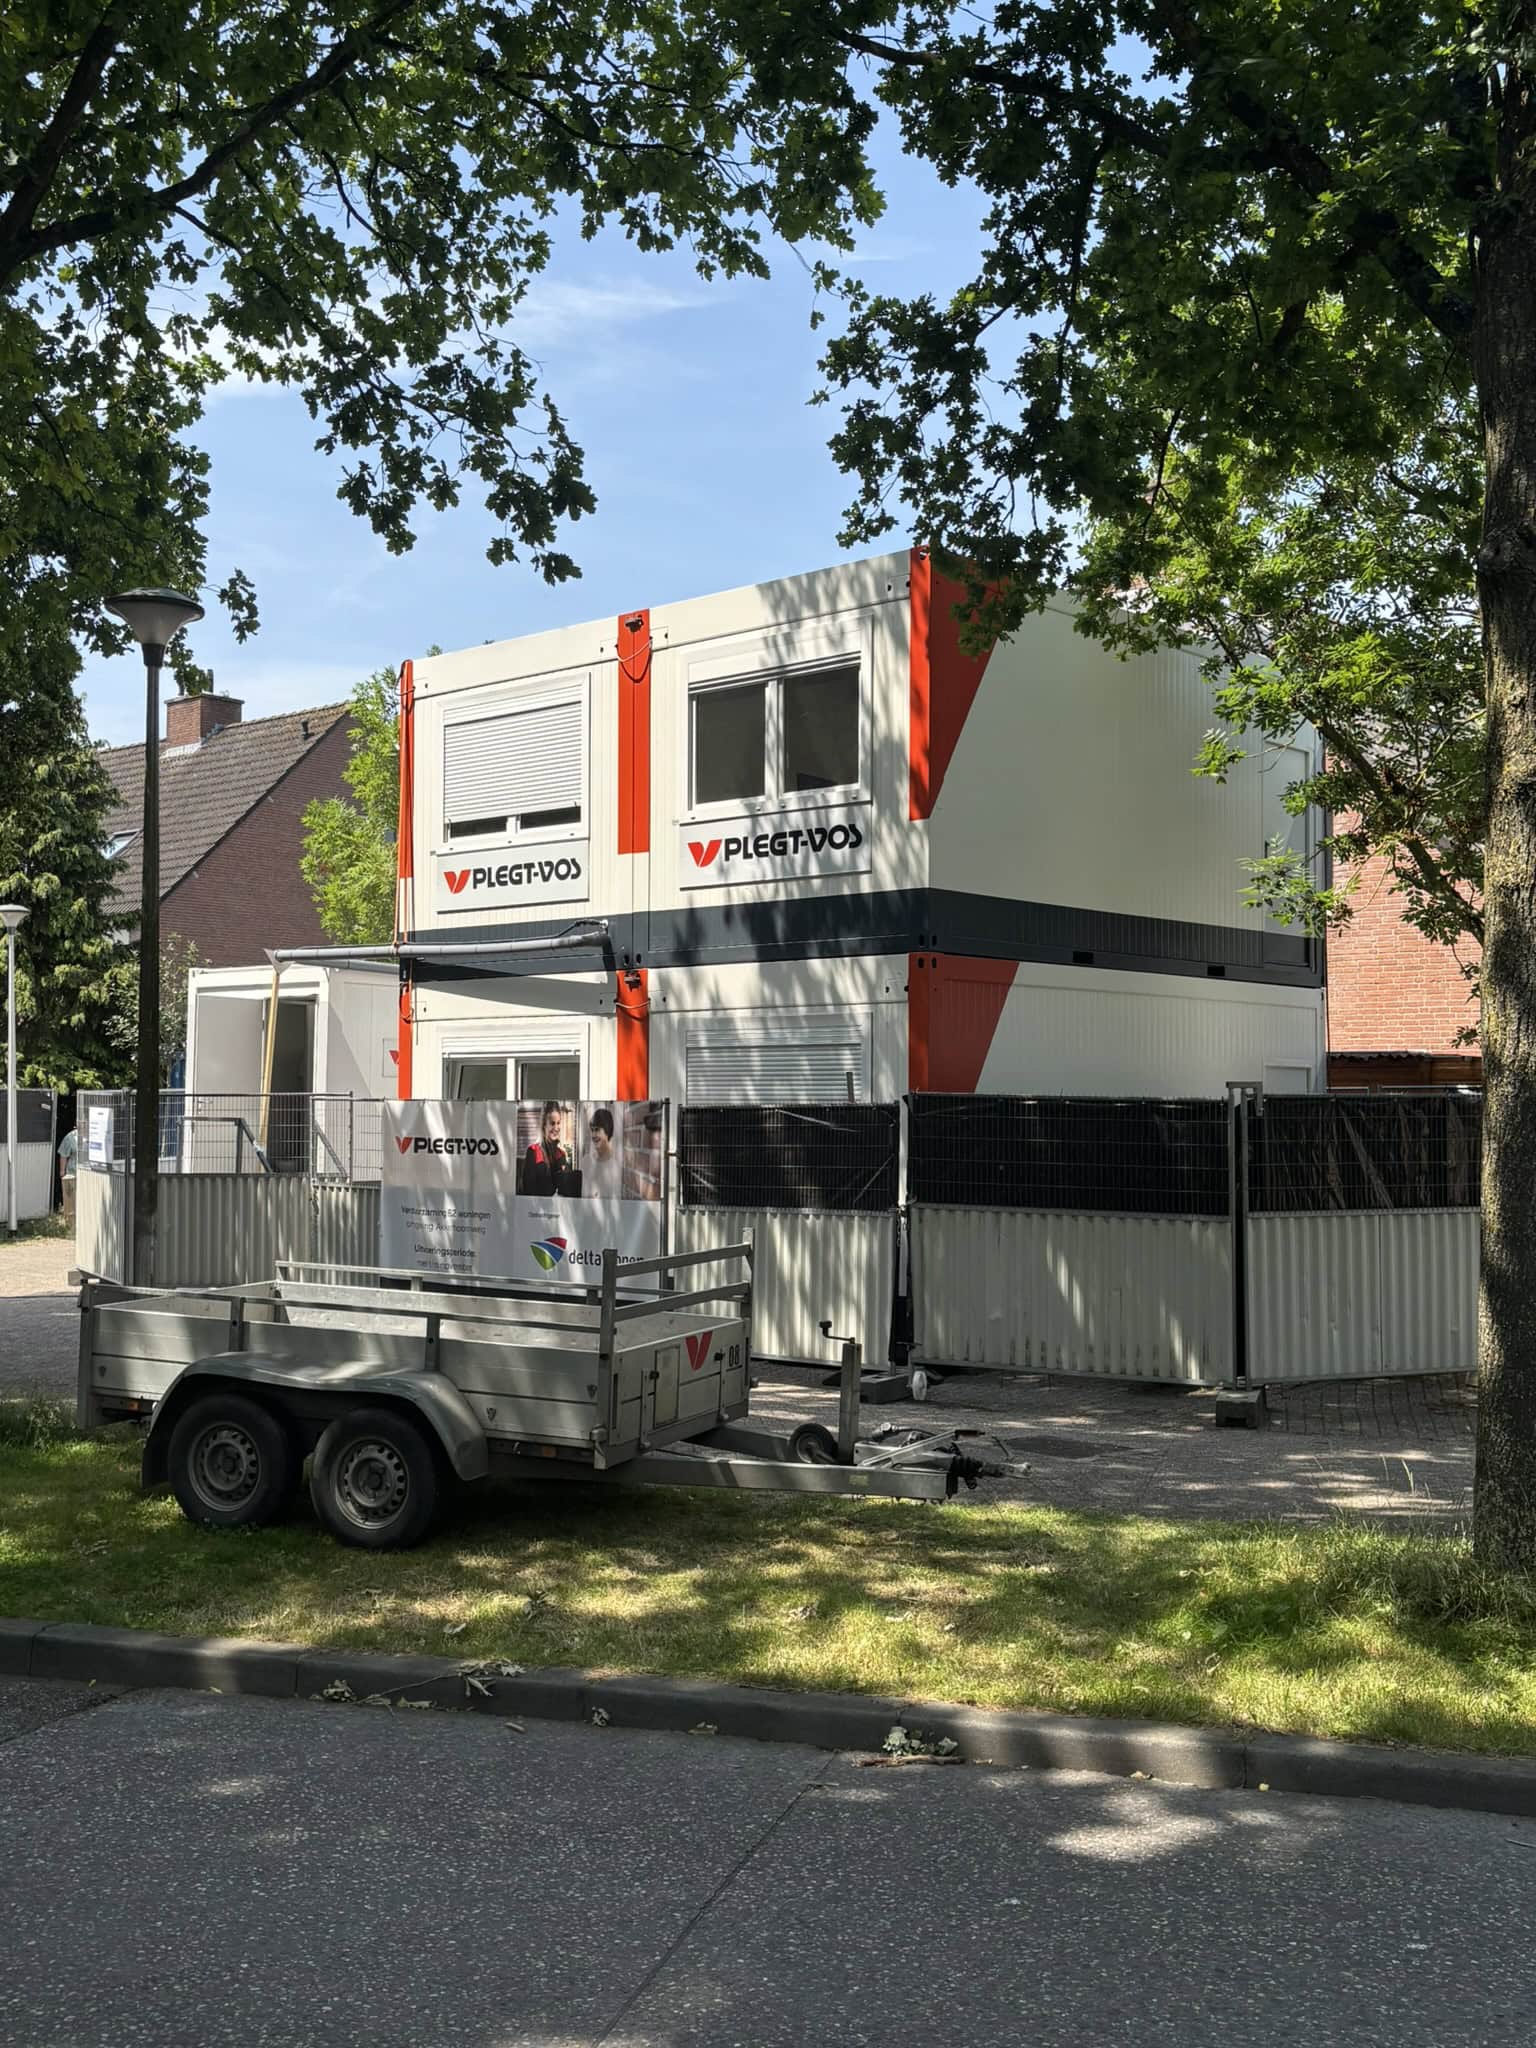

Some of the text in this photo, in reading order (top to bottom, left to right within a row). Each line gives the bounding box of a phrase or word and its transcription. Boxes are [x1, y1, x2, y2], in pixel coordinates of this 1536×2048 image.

[724, 824, 863, 861] PLEGT-VOS
[473, 858, 582, 889] PLEGT-VOS
[414, 1137, 499, 1156] PLEGT-VOS
